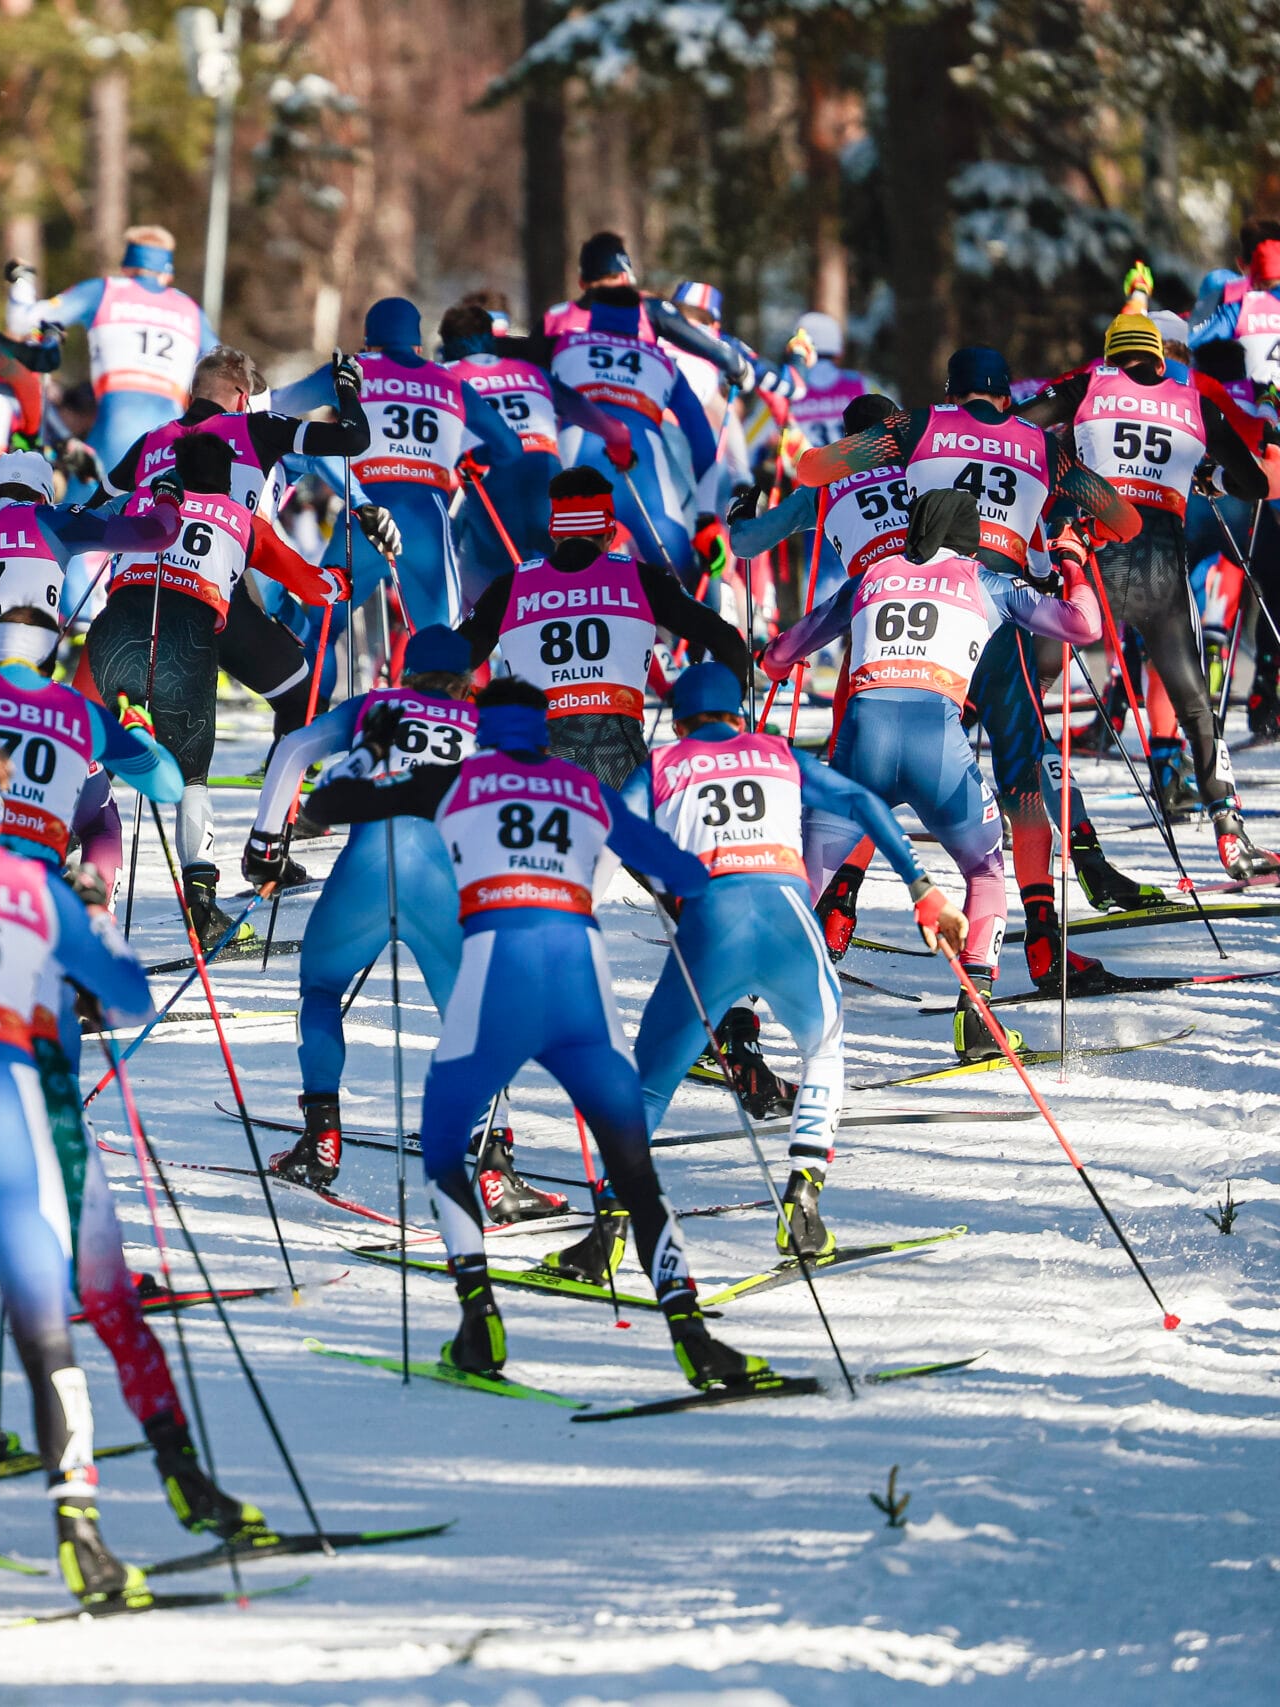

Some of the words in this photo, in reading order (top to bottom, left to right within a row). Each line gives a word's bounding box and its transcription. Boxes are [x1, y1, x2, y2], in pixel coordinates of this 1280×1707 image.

[136, 328, 175, 360] 12
[588, 346, 642, 375] 54
[469, 374, 544, 392] OBILL
[595, 371, 635, 385] FALUN
[361, 378, 460, 410] MOBILL
[382, 404, 439, 444] 36
[1093, 396, 1198, 430] MOBILL
[389, 443, 432, 458] FALUN
[932, 433, 1042, 472] MOBILL
[1113, 422, 1172, 465] 55
[362, 464, 435, 480] Swedbank
[828, 465, 902, 499] MOBI
[953, 462, 1017, 507] 43
[1118, 464, 1162, 480] FALUN
[855, 479, 908, 521] 58
[1113, 483, 1163, 503] dbank
[138, 497, 242, 534] MBILL
[875, 516, 908, 532] FALU
[979, 505, 1008, 522] LUN
[860, 537, 904, 567] Swedb
[517, 586, 639, 620] MOBILL
[862, 575, 972, 603] MOBILL
[875, 602, 939, 641] 69
[540, 617, 610, 665] 80
[880, 645, 926, 657] FALUN
[551, 666, 604, 683] FALUN
[548, 691, 611, 711] edbank
[395, 720, 463, 761] 63
[664, 750, 790, 789] MOBILL
[12, 783, 44, 803] LUN
[469, 773, 600, 811] MOBILL
[698, 780, 766, 826] 39
[5, 808, 47, 833] bank
[498, 802, 572, 855] 84
[714, 827, 763, 843] FALUN
[508, 855, 564, 873] FALUN
[478, 883, 571, 904] Swedbank
[1147, 904, 1195, 917] FISCHER
[795, 1084, 830, 1136] FIN
